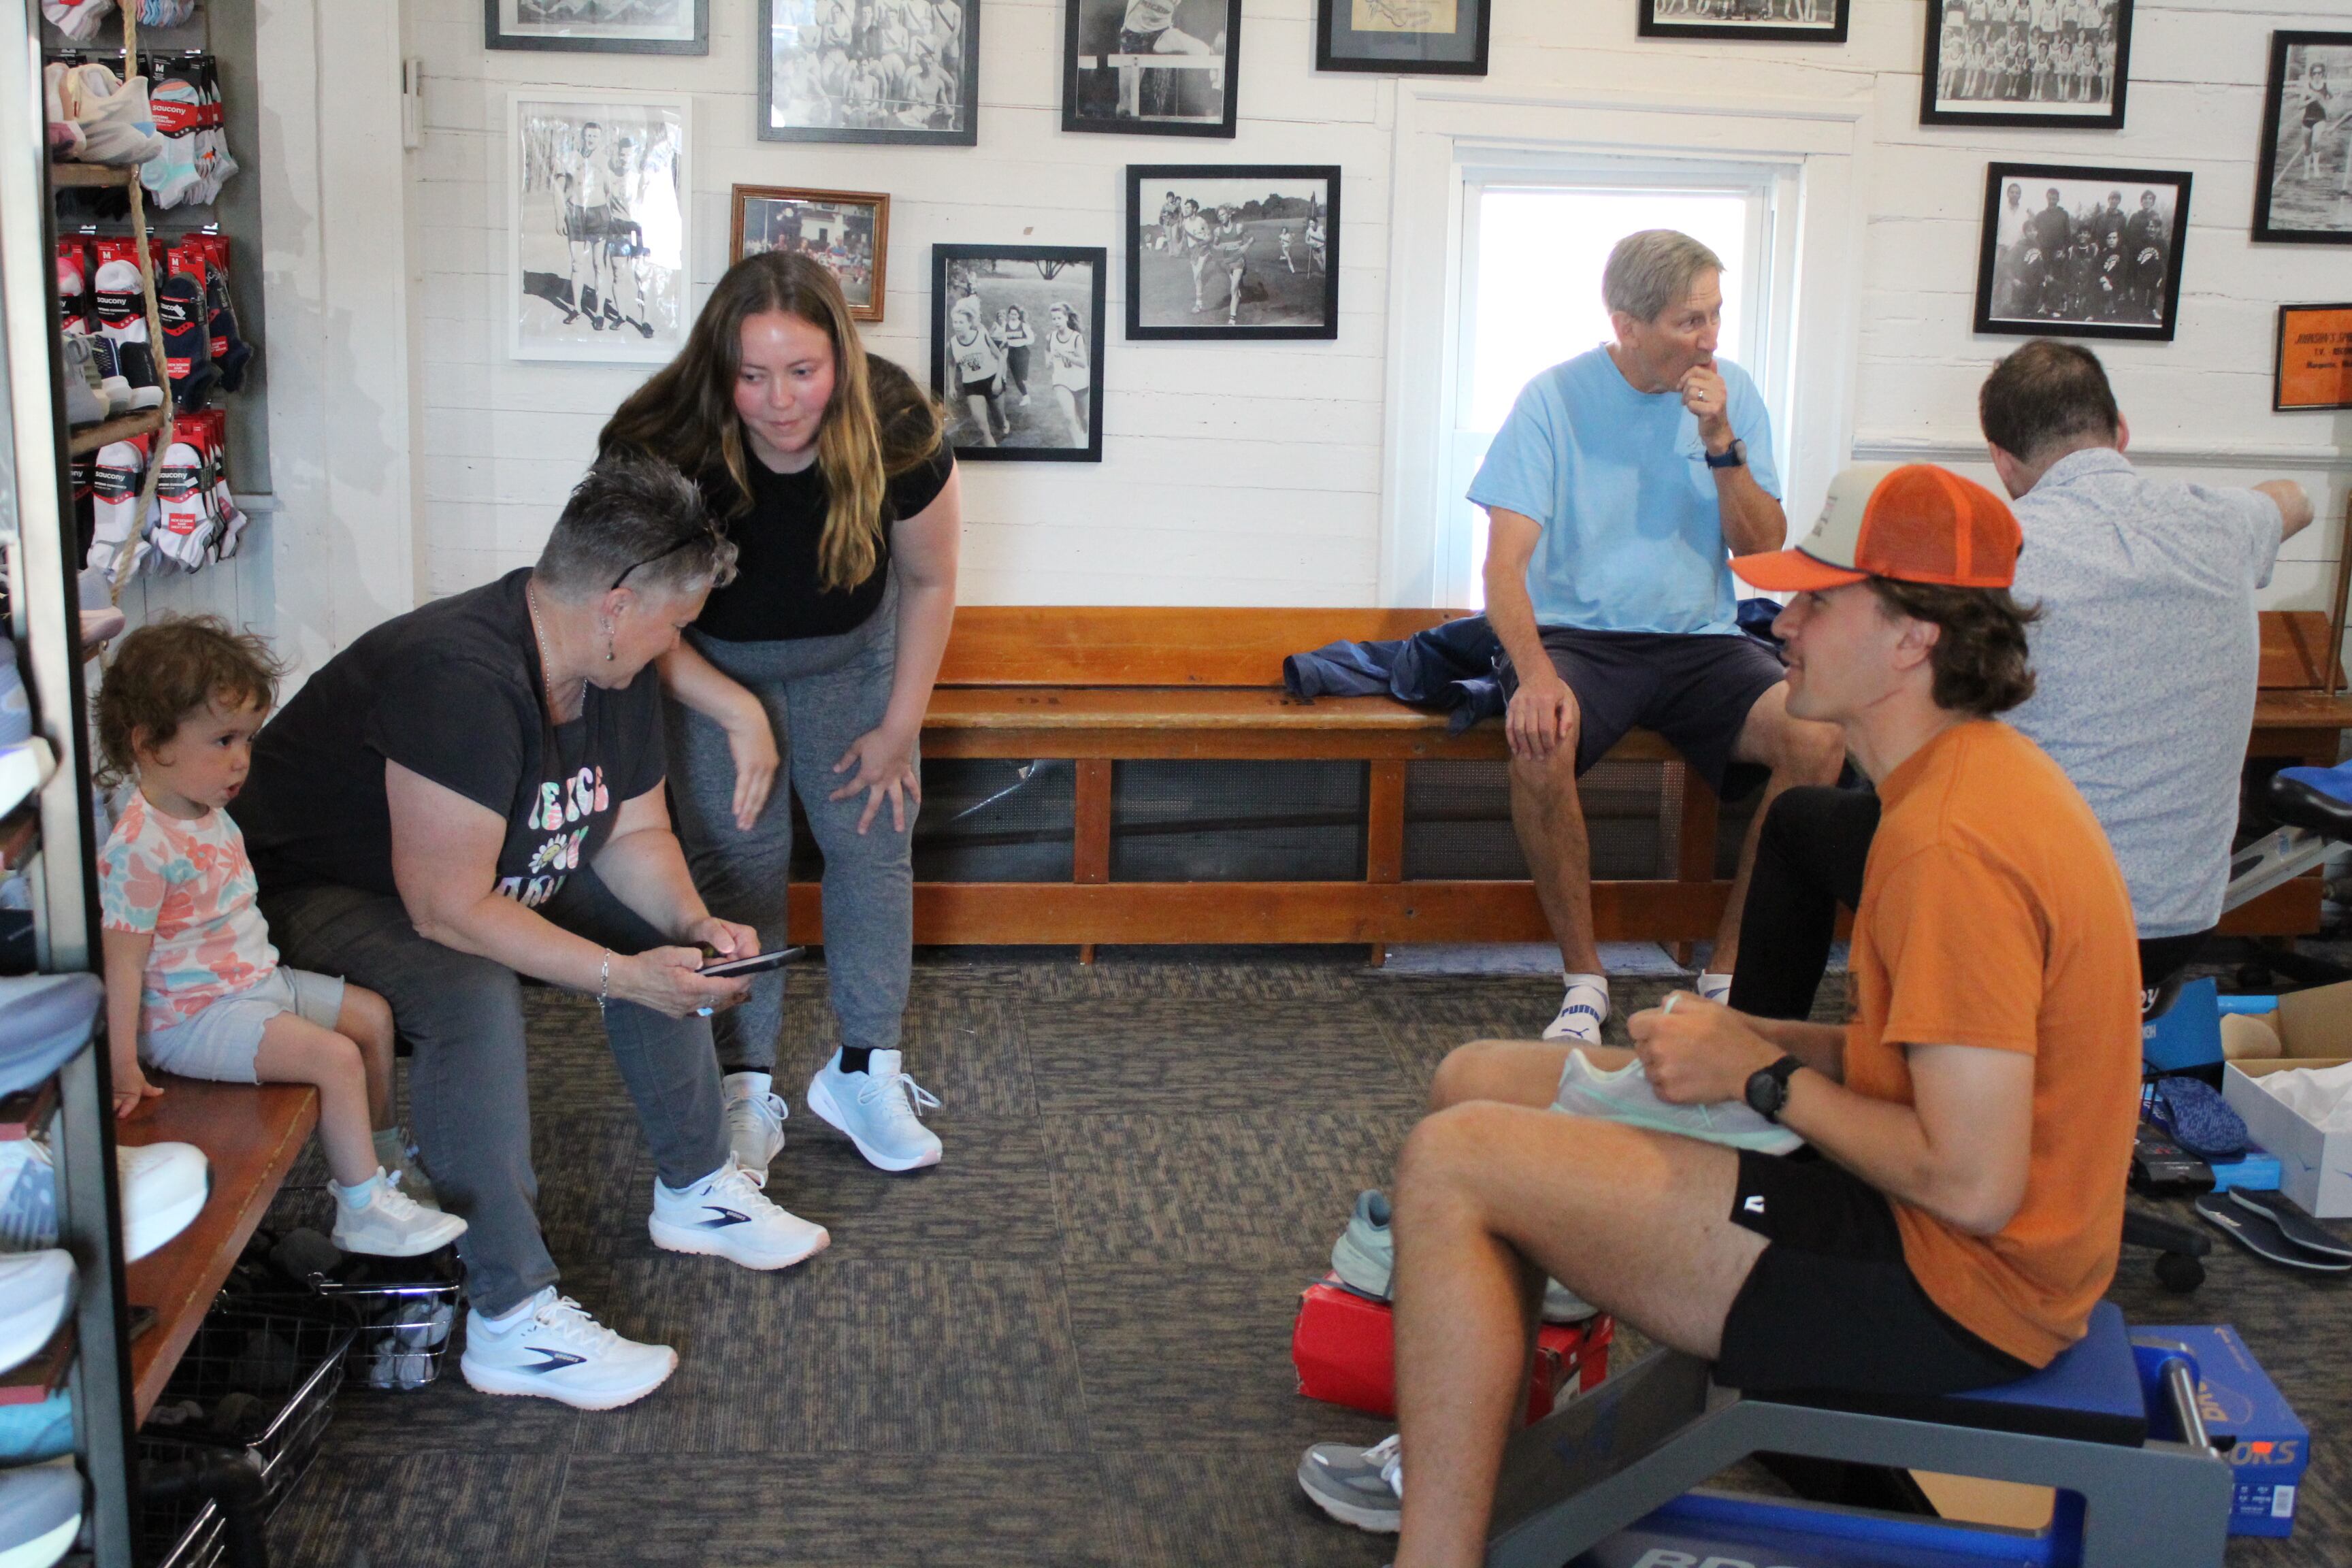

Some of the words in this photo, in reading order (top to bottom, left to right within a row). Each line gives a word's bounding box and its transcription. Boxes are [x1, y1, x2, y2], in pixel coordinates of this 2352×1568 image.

[155, 63, 165, 72] M
[152, 104, 186, 116] saucony
[172, 258, 179, 266] M
[97, 297, 127, 306] saucony
[95, 470, 126, 482] saucony
